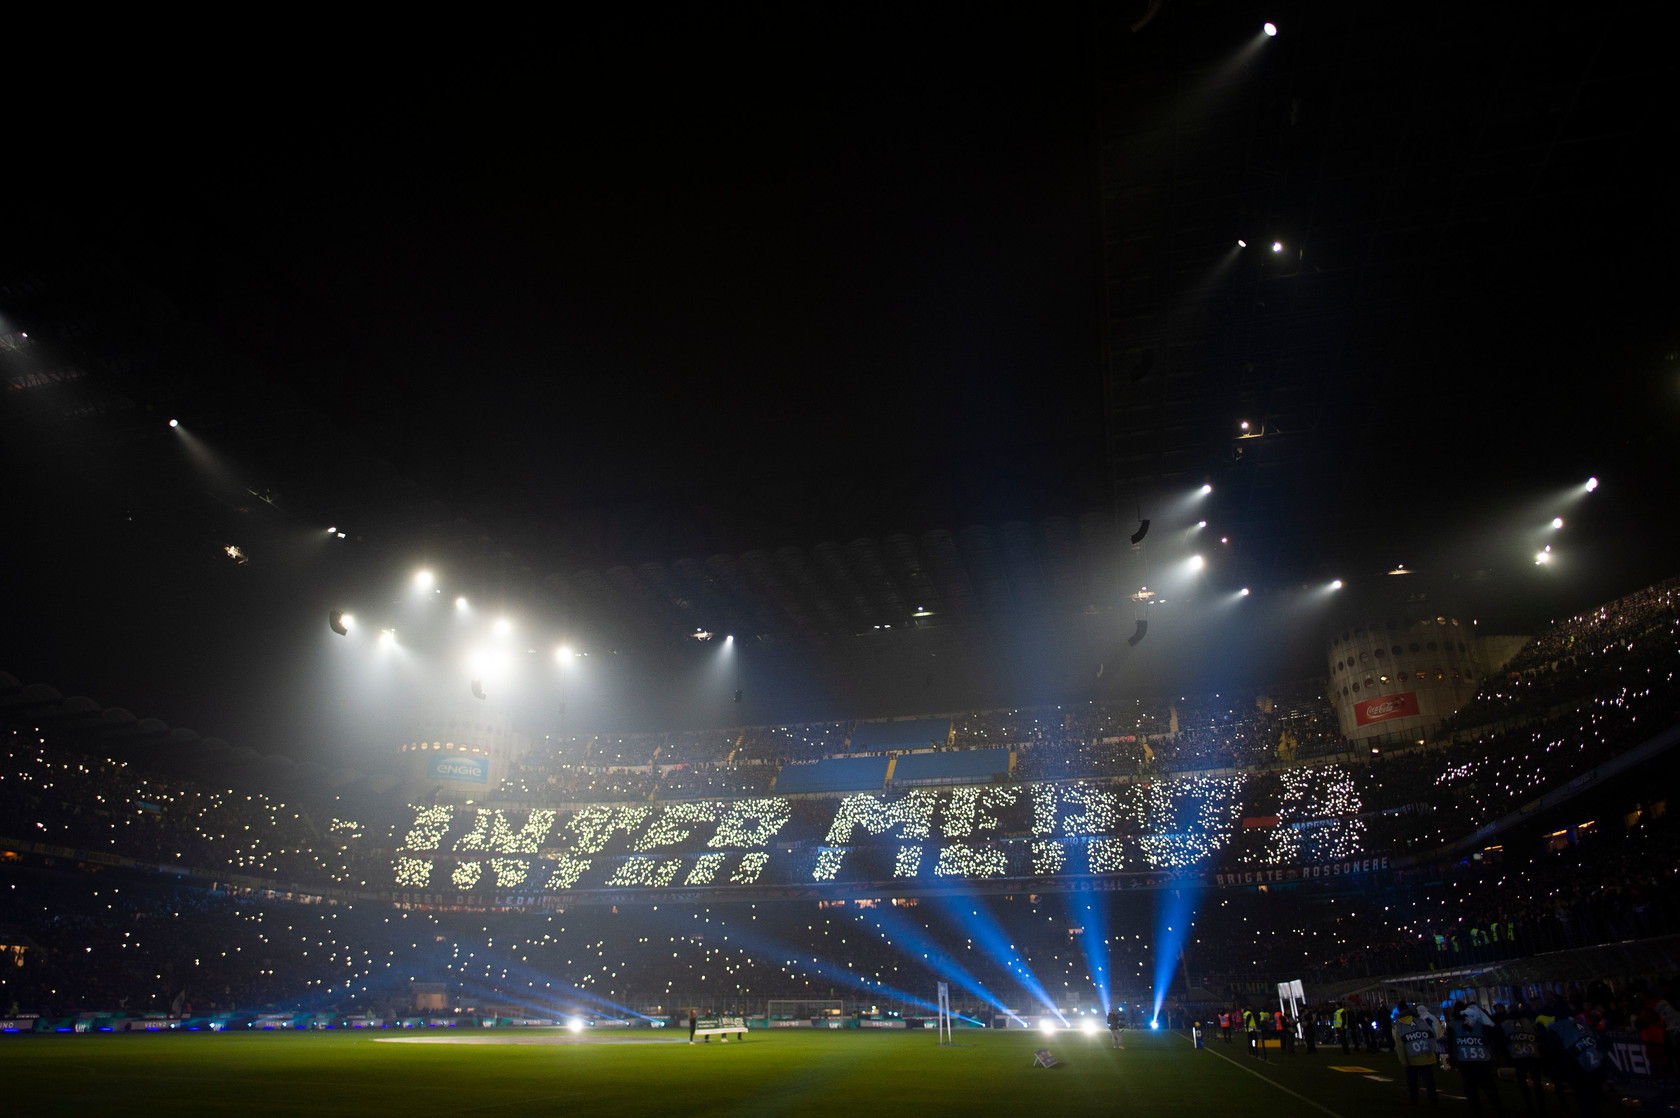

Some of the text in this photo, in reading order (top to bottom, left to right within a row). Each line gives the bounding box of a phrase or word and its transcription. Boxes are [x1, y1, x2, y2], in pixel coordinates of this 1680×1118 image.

[393, 796, 791, 890] INTER
[1216, 869, 1283, 885] BRIGATE
[1303, 857, 1388, 878] ROSSONERE
[392, 892, 542, 906] FOSSA DEI LEONI
[1461, 1047, 1486, 1059] 153
[1607, 1042, 1651, 1075] NTE
